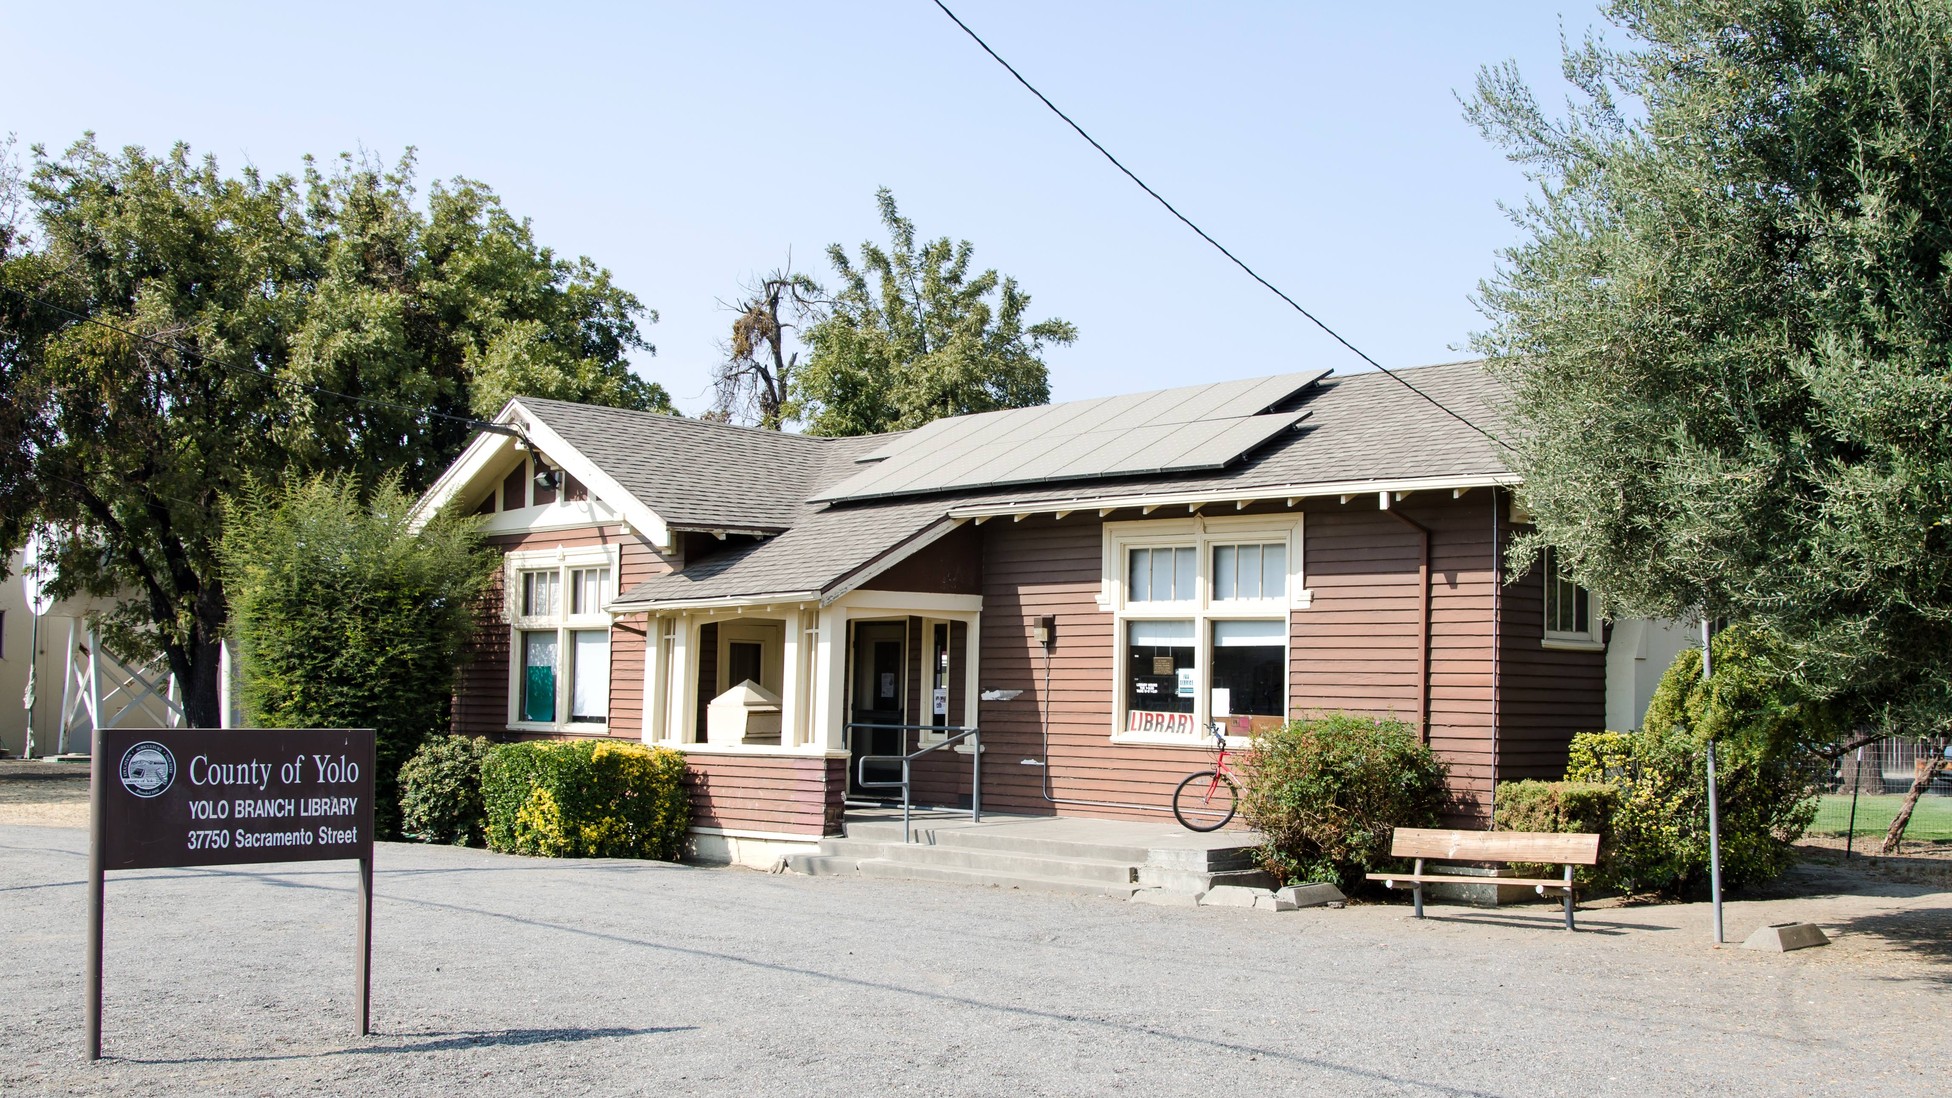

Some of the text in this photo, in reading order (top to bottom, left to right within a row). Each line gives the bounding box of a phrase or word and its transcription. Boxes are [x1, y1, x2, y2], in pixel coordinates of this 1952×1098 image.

[189, 754, 359, 790] County of Yolo
[188, 797, 358, 820] YOLO BRANCH LIBRARY
[187, 826, 358, 850] 37750 Sacramento Street
